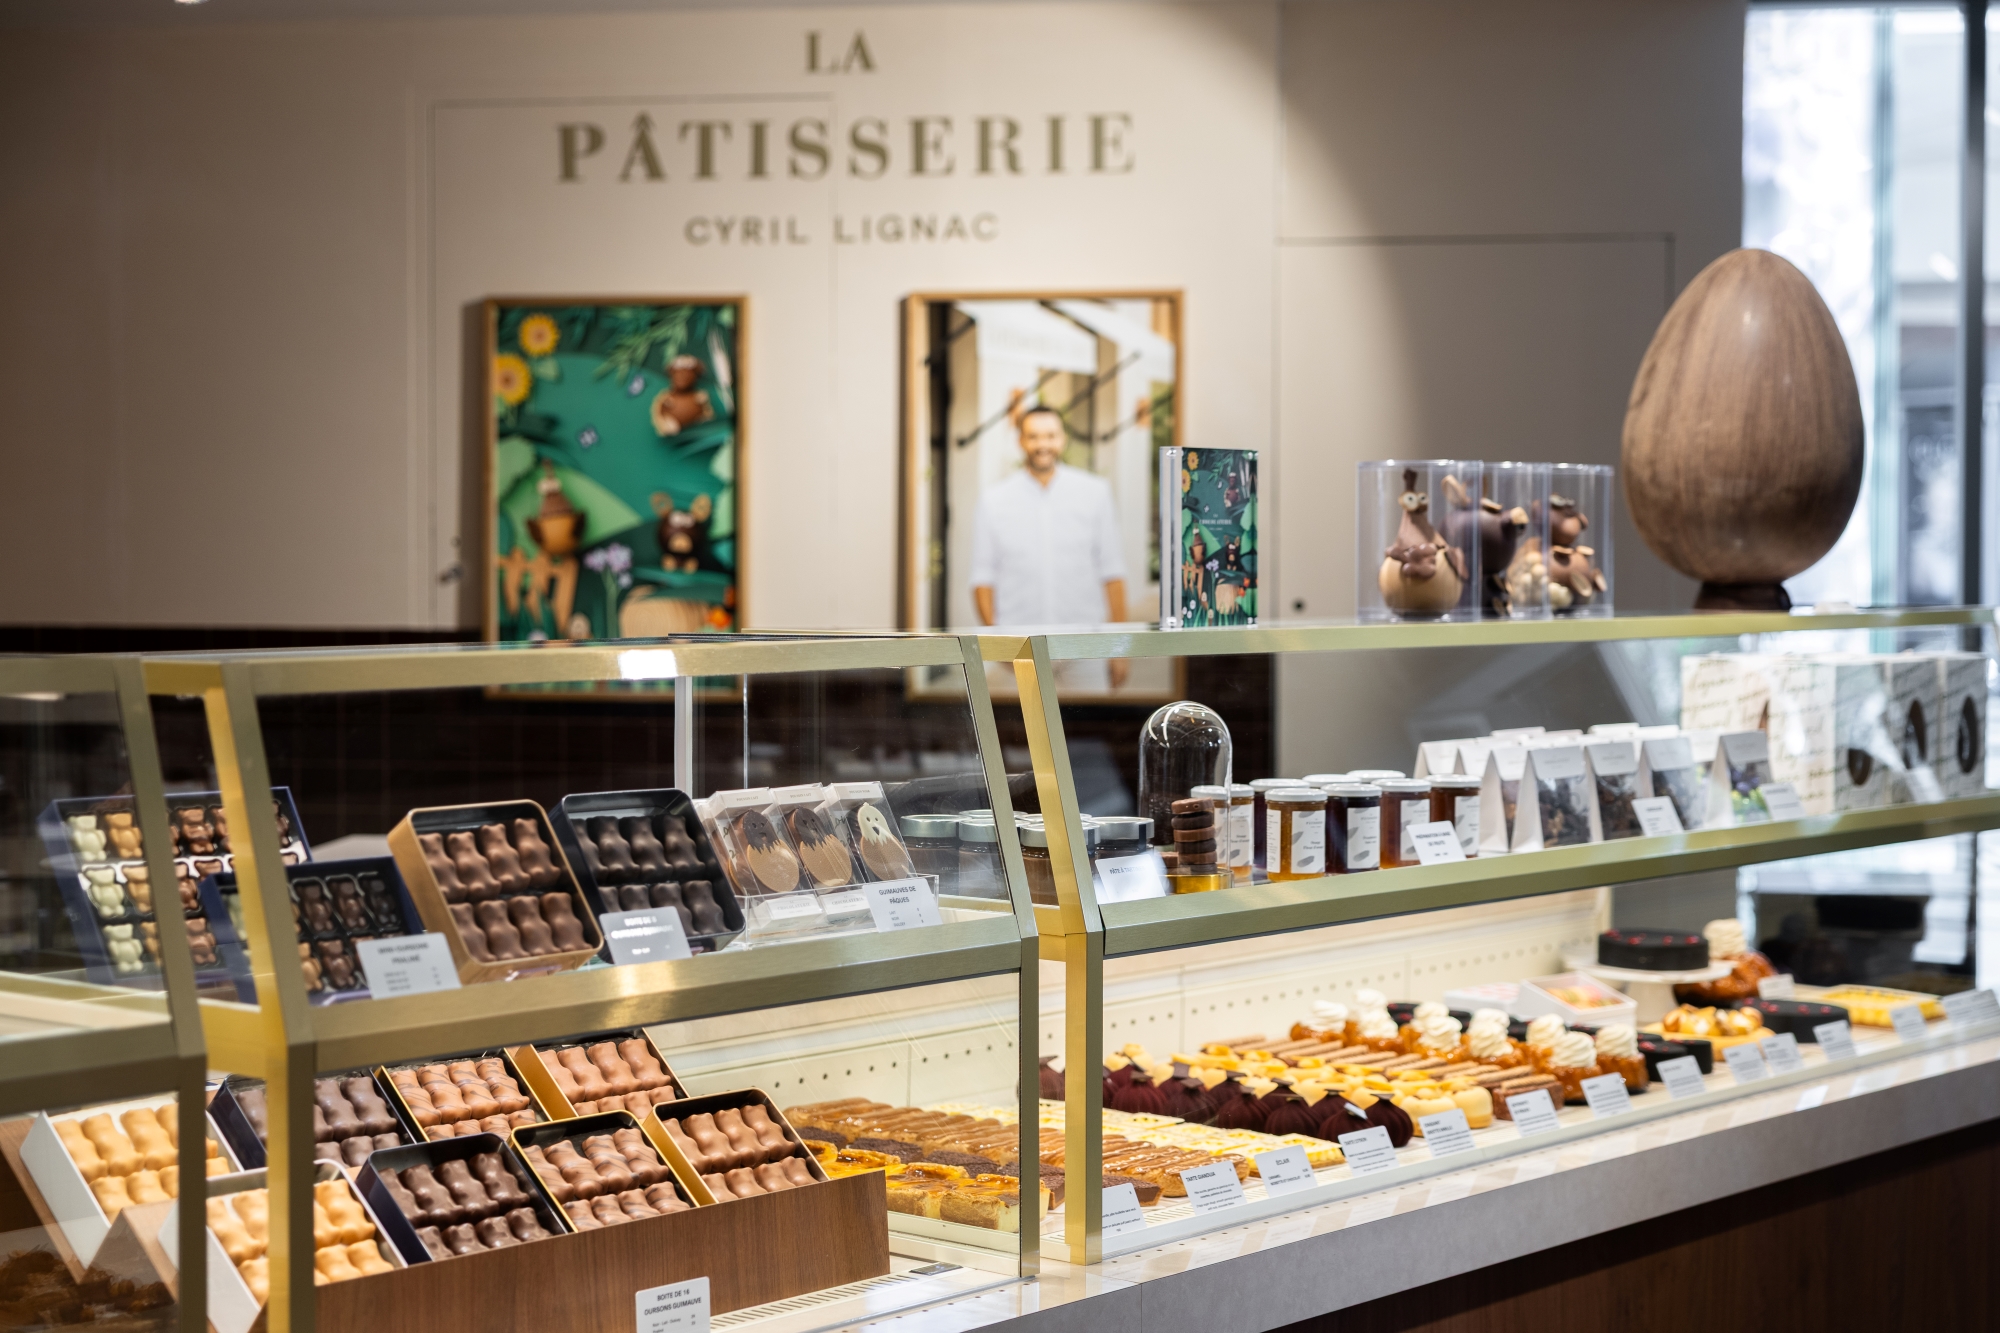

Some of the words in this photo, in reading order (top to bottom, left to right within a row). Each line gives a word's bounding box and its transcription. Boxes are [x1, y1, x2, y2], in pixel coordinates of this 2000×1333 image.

[804, 28, 877, 75] LA
[555, 111, 1136, 184] PÂTISSERIE
[683, 215, 811, 246] CYRIL
[833, 211, 1000, 244] LIGNAC
[878, 886, 909, 896] GUIMAUVES
[889, 896, 910, 904] PÂQUES
[645, 1304, 672, 1315] OURSONS
[673, 1297, 702, 1309] GUIMAUVE
